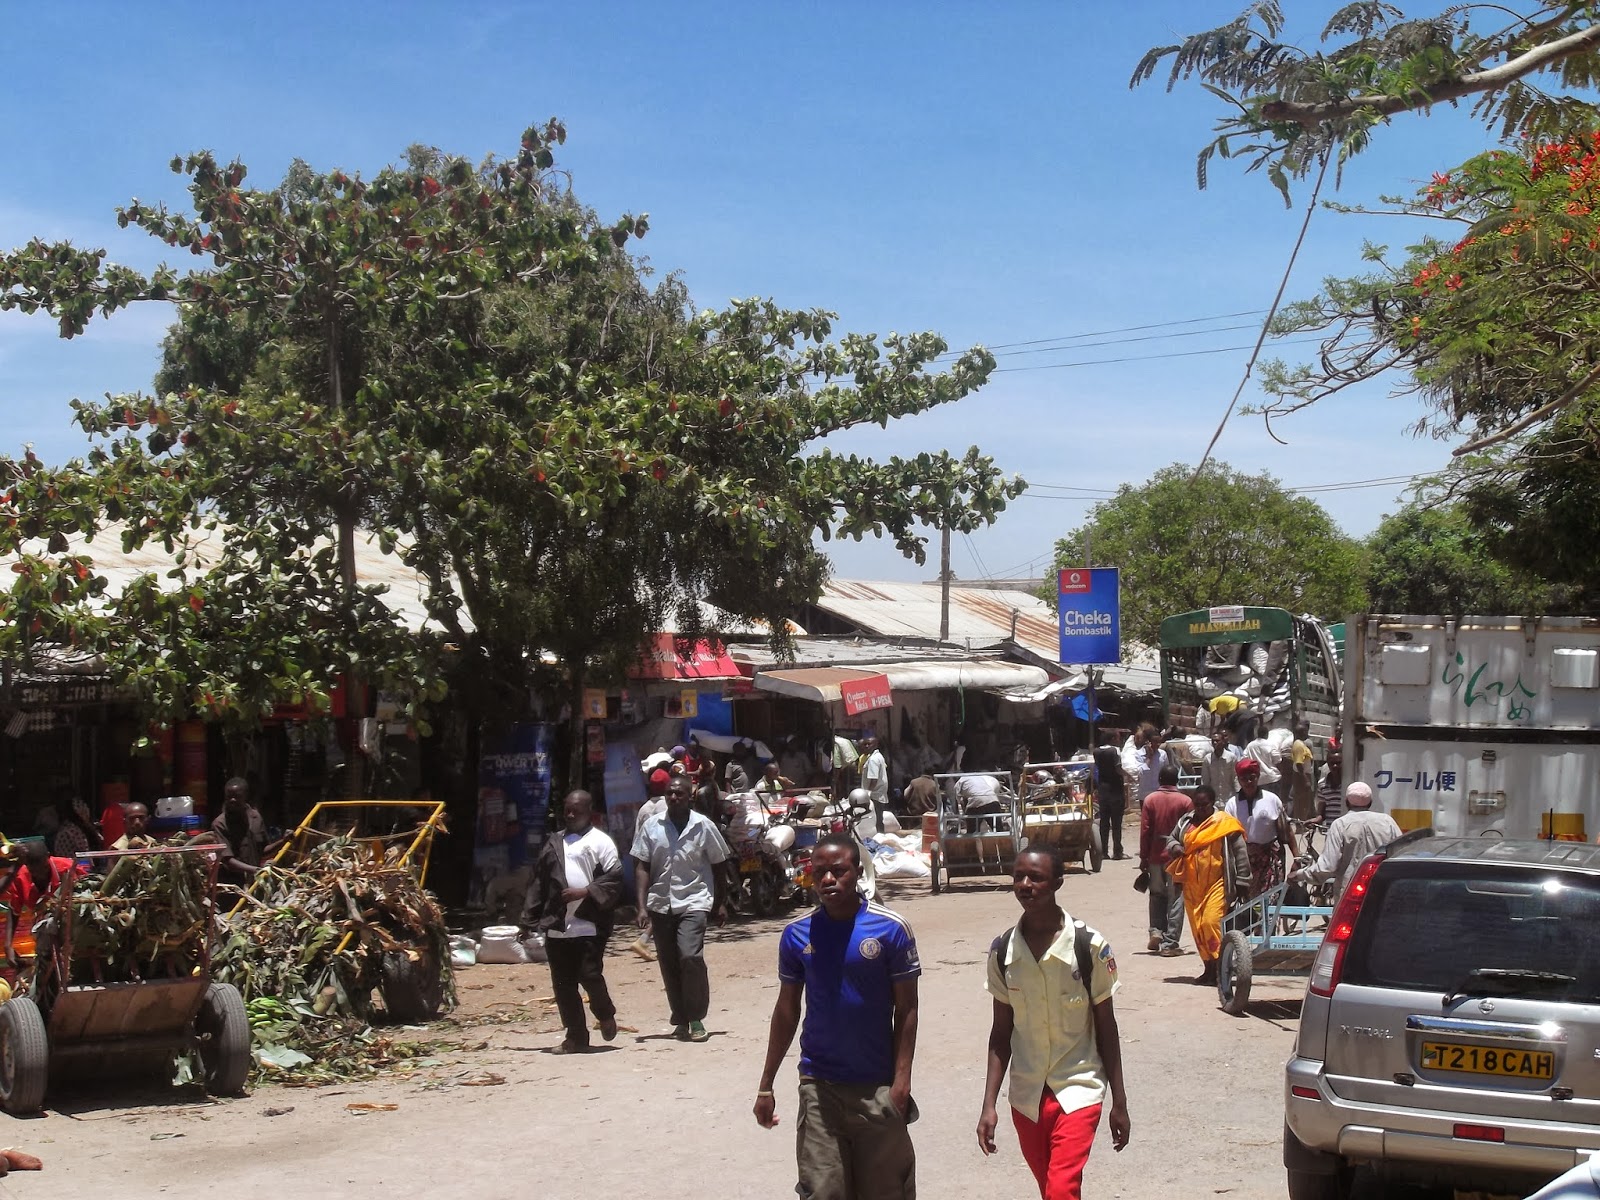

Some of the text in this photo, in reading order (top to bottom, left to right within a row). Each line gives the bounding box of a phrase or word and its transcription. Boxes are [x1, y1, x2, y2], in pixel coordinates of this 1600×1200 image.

[1065, 610, 1112, 626] Cheka
[1065, 626, 1112, 636] Bombastik
[1374, 770, 1456, 792] クール便
